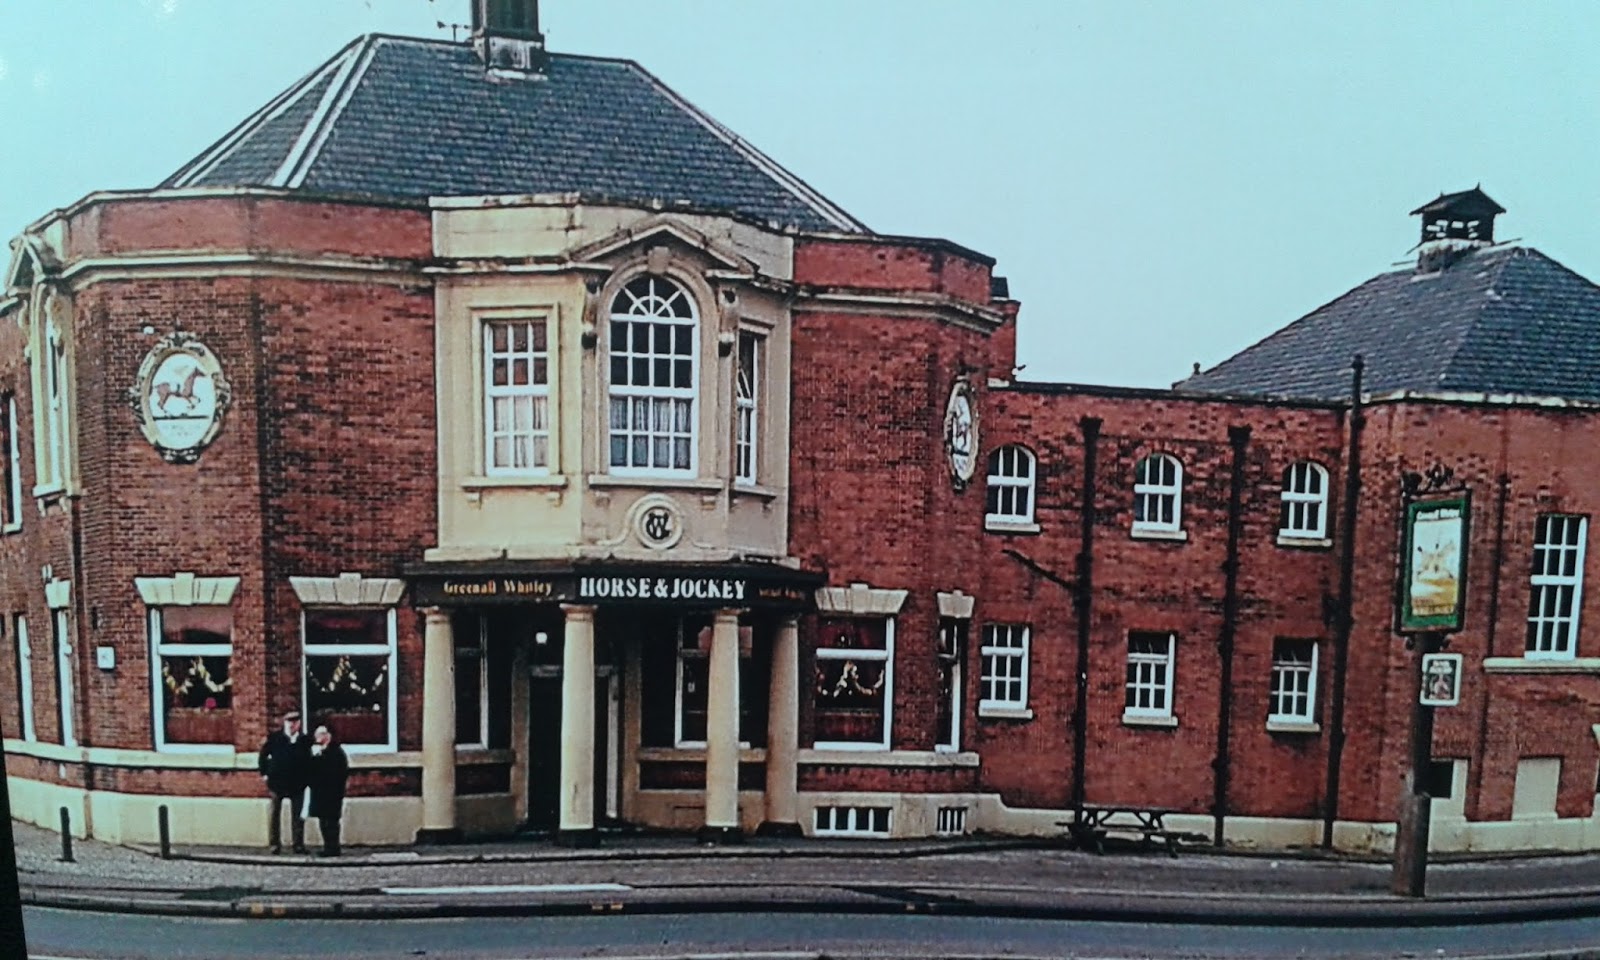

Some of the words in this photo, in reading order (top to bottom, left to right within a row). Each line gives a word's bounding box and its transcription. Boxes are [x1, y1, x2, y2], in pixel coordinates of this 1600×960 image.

[443, 580, 496, 594] Greenall
[580, 577, 651, 598] HORSE
[654, 578, 667, 598] &
[670, 578, 745, 599] JOCKEY
